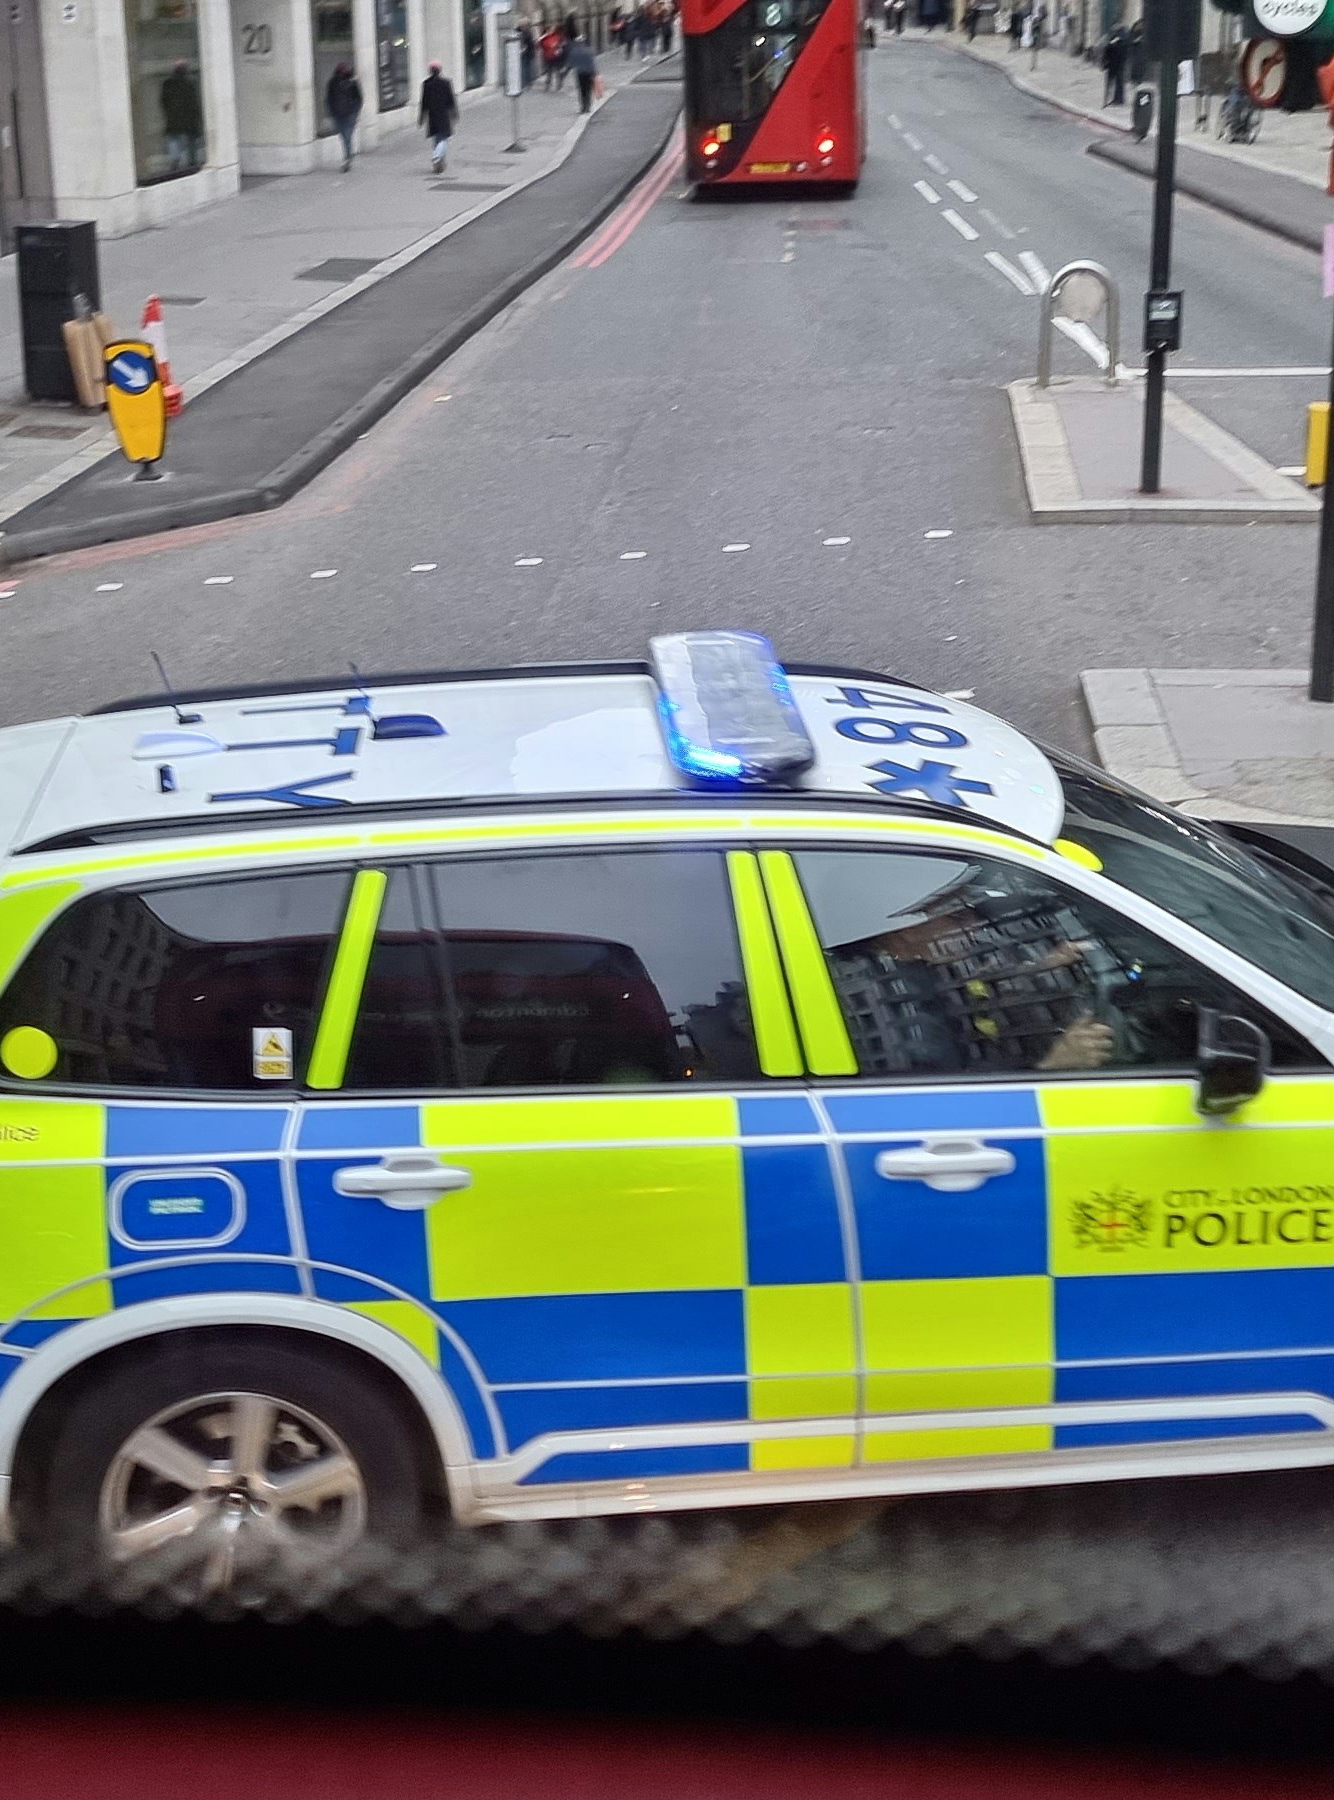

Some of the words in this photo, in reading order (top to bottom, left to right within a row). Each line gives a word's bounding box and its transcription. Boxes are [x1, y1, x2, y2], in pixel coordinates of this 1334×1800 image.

[766, 3, 781, 27] 8
[241, 24, 272, 55] 20
[1165, 1208, 1333, 1248] POLICE
